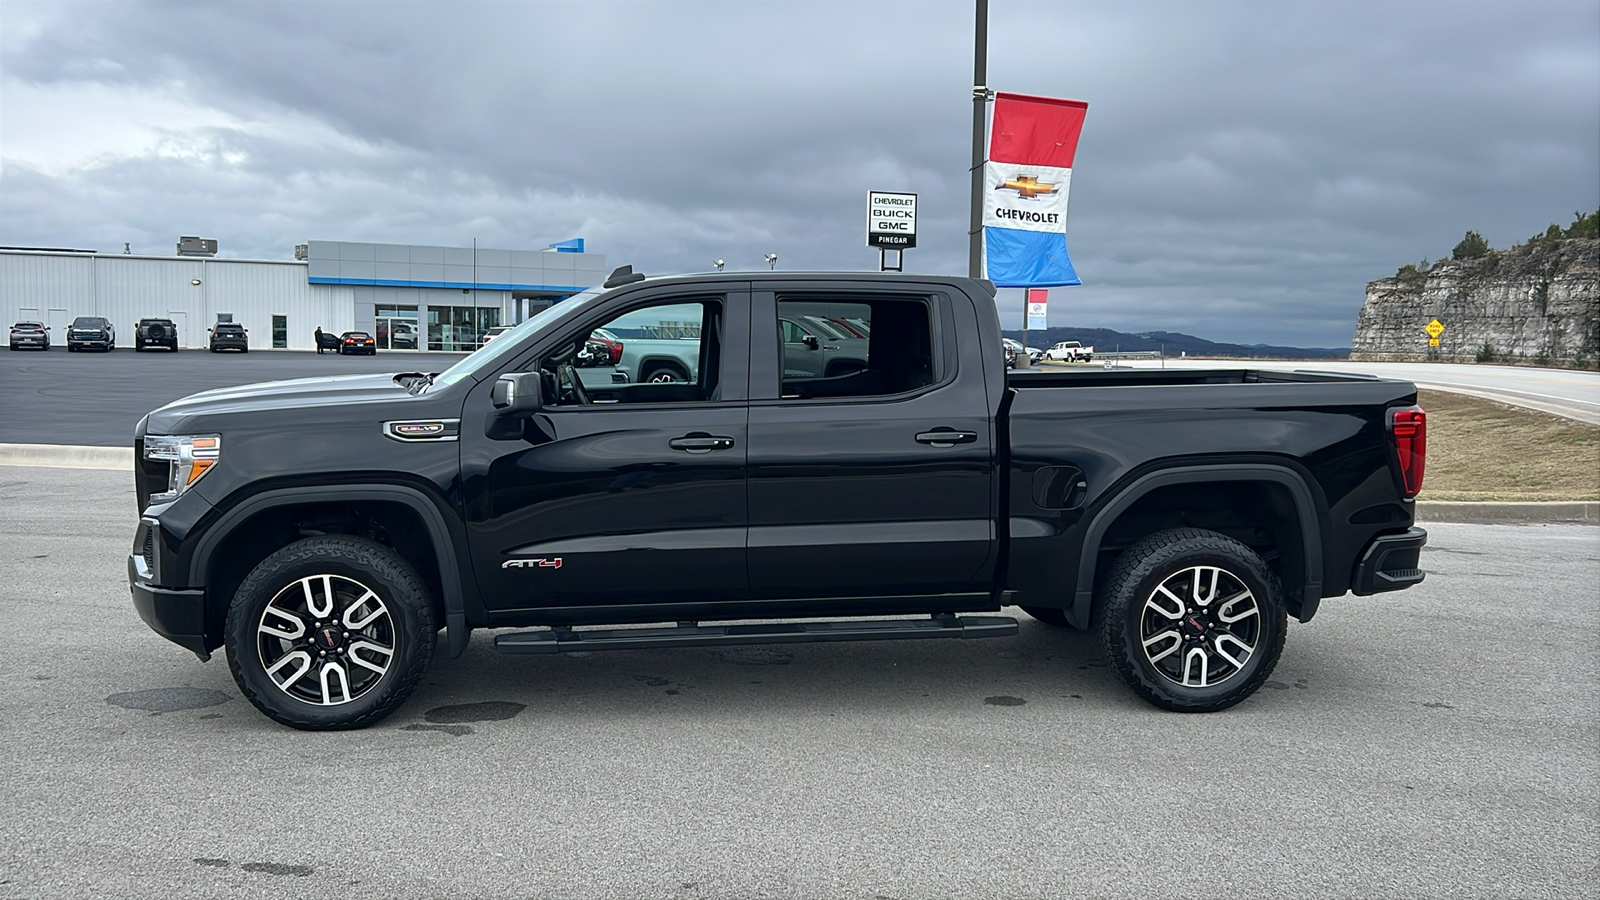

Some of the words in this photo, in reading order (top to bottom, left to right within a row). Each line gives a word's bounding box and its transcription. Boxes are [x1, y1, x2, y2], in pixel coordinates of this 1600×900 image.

[874, 197, 913, 206] CHEVROLET
[873, 209, 913, 218] BUICK
[995, 207, 1059, 223] CHEVROLET
[878, 221, 908, 230] GMC
[878, 236, 908, 244] PINEGAR
[502, 558, 563, 569] AT4
